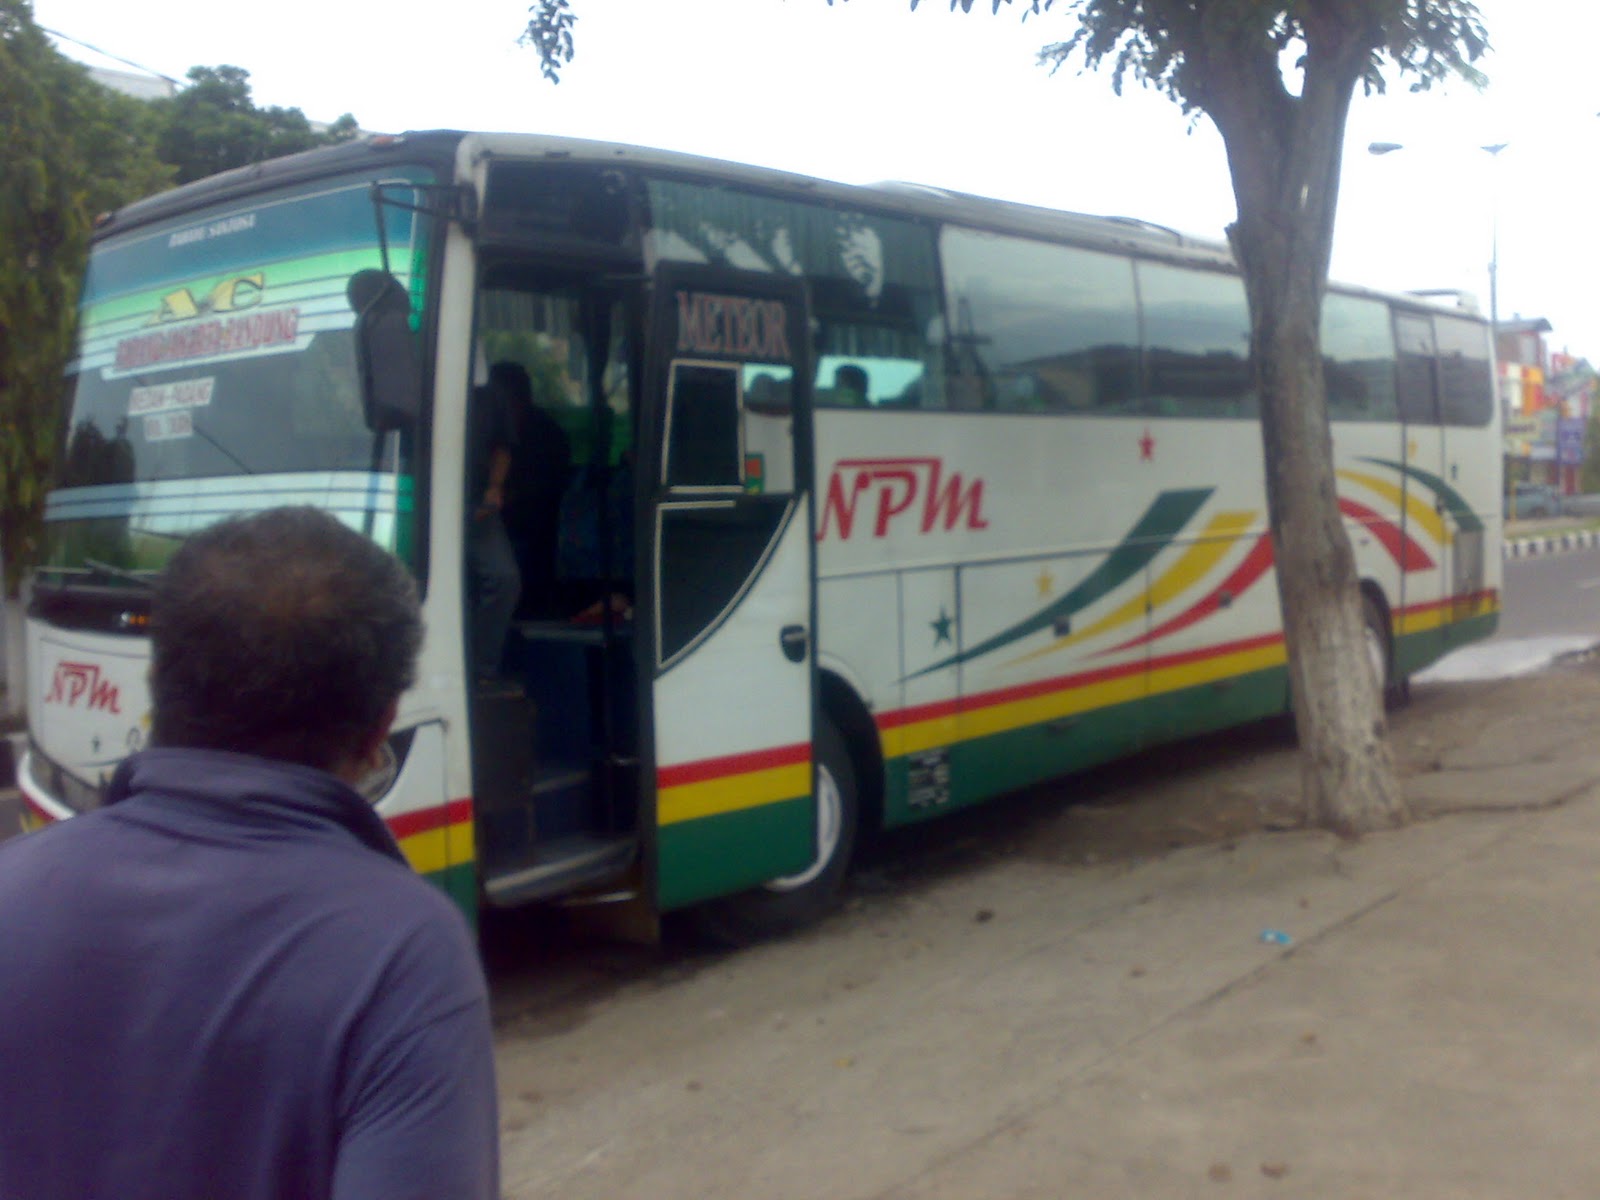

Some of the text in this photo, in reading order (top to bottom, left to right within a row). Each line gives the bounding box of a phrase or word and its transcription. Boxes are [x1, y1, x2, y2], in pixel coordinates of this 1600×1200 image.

[676, 290, 792, 360] METEOR
[815, 457, 989, 542] NPM
[45, 660, 121, 714] NPM
